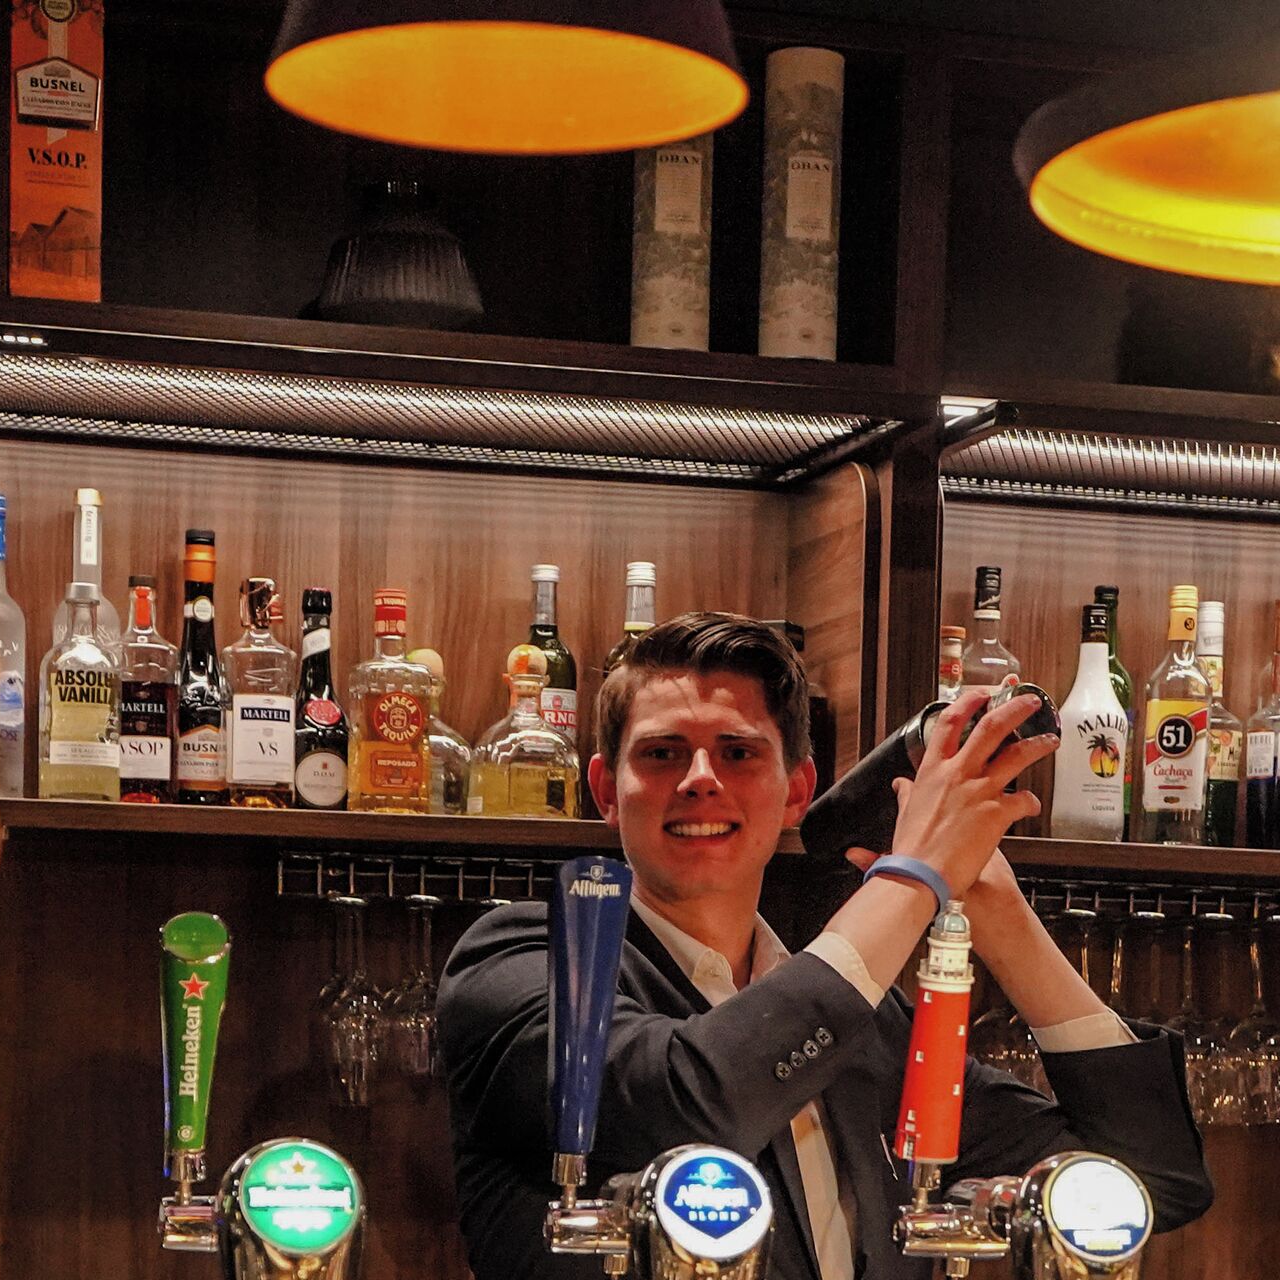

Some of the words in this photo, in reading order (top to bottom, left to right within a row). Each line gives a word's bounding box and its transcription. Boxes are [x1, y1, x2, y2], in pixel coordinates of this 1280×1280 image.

[30, 77, 86, 94] BUSNEL
[28, 147, 88, 170] V.S.O.P.
[659, 154, 700, 165] OBAN
[791, 160, 831, 172] OBAN
[380, 696, 417, 714] OLMECA
[243, 708, 289, 721] MARTELL
[378, 724, 419, 742] TEQUILA
[1162, 725, 1187, 748] 51
[183, 742, 218, 752] BUSN
[258, 741, 278, 756] VS
[377, 759, 417, 768] REPOSADO
[1153, 764, 1194, 781] Cachaça
[569, 879, 621, 899] Affligem
[178, 1004, 202, 1103] Heineken
